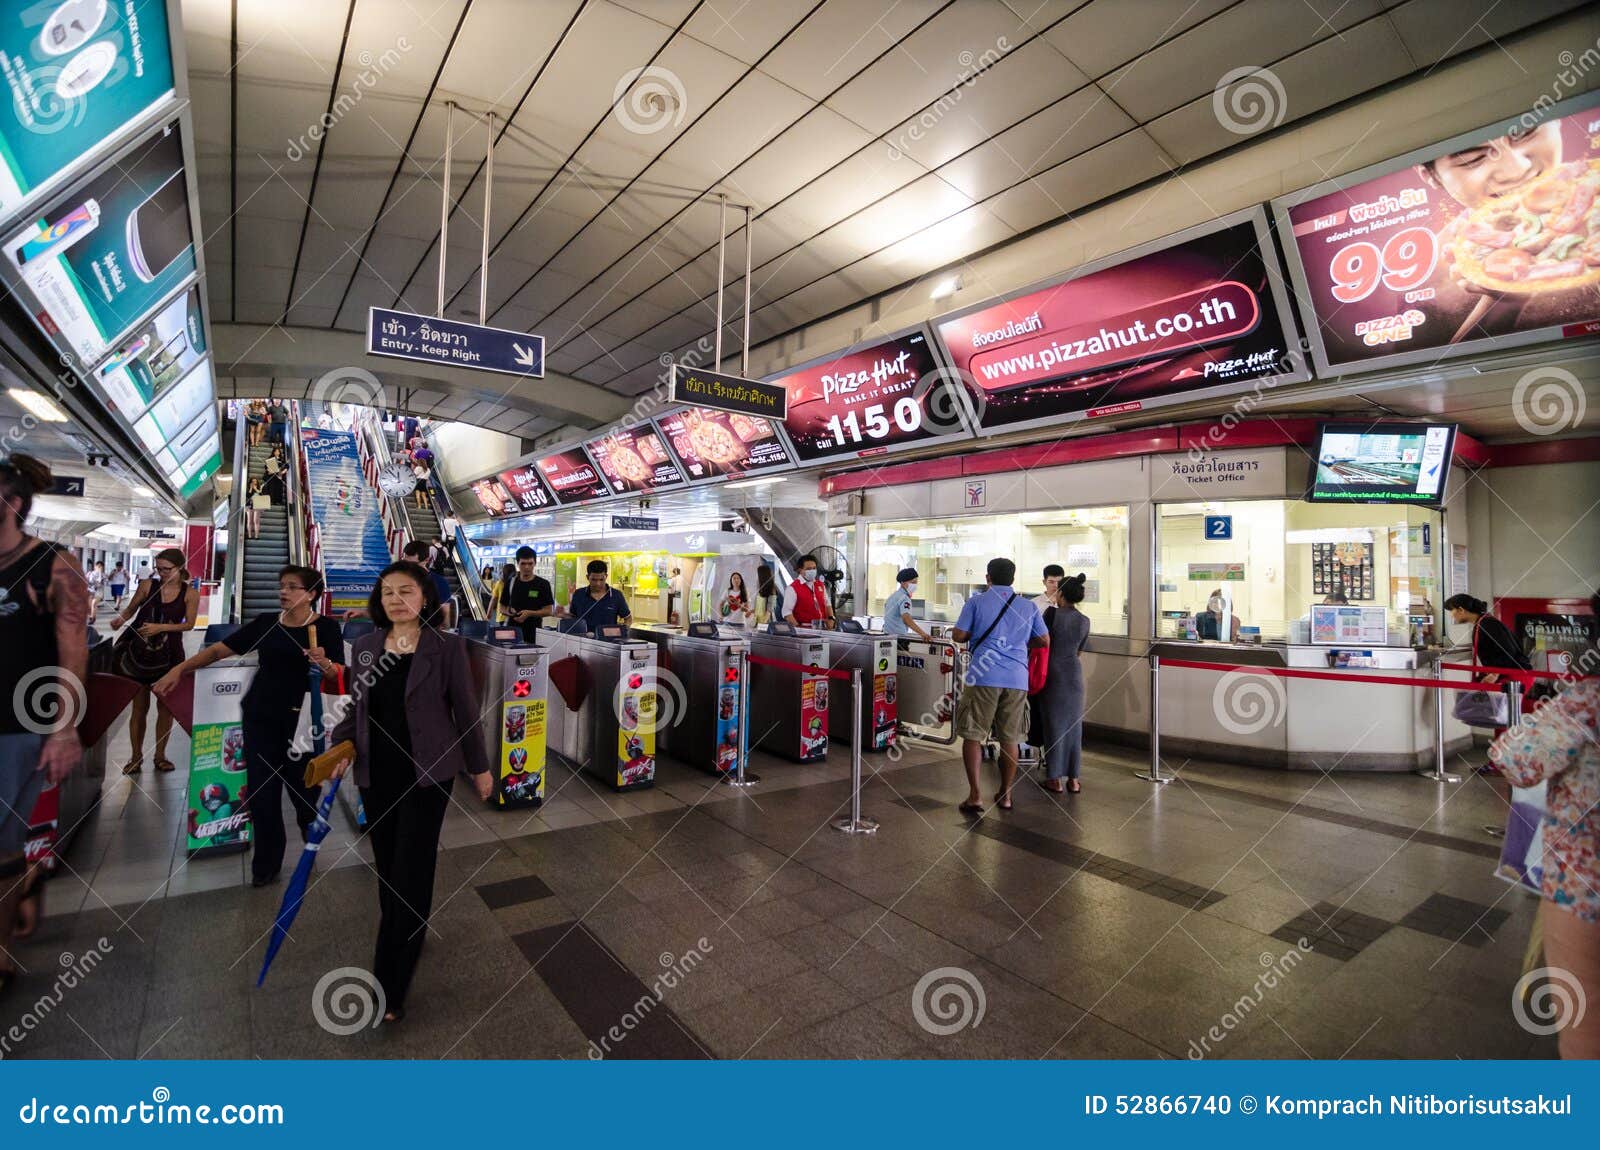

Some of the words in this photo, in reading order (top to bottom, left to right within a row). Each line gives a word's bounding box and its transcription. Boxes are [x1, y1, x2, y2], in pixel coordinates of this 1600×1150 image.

[1330, 227, 1438, 303] 99
[382, 319, 406, 336] เข้า
[420, 323, 468, 346] ชิดขวา
[973, 311, 1042, 347] สั่งออนไลน์ที่
[1355, 315, 1406, 335] PIZZA
[980, 297, 1236, 380] www.pizzahut.co.th
[1364, 326, 1412, 346] ONE
[381, 338, 413, 352] Entry
[421, 343, 449, 357] Keep
[452, 348, 480, 362] Right
[1204, 358, 1245, 378] Pizza
[1246, 348, 1279, 368] Hut
[821, 371, 870, 404] Pizza
[871, 350, 910, 387] Hut
[1220, 370, 1239, 378] MAKE
[843, 393, 867, 404] MAKE
[870, 390, 879, 398] IT
[882, 380, 914, 395] GREAT
[826, 397, 921, 446] 1150
[1172, 456, 1259, 474] ห้องตั๋วโดยสาร
[1187, 475, 1212, 483] Ticket
[1217, 473, 1245, 482] Office
[521, 487, 548, 507] 1150
[1212, 520, 1226, 536] 2
[1525, 619, 1590, 638] ตู้ดับเพลิง
[519, 667, 535, 677] G05
[215, 683, 239, 694] G07
